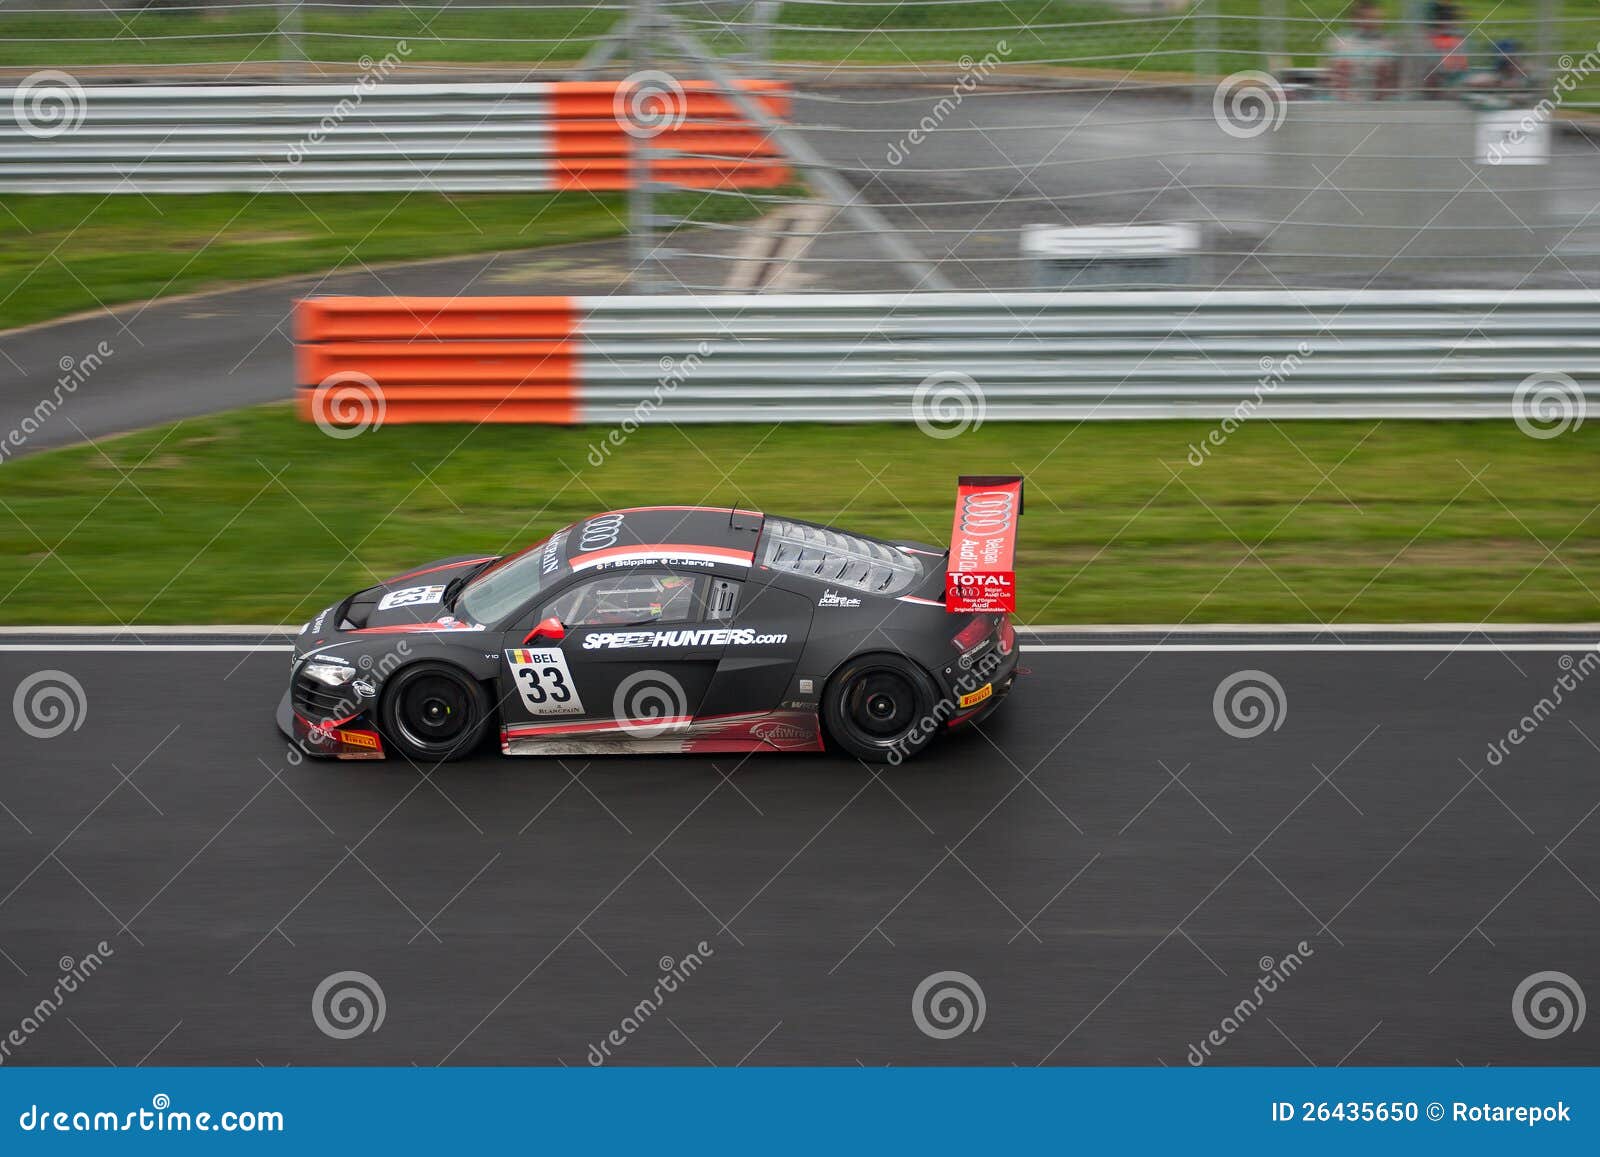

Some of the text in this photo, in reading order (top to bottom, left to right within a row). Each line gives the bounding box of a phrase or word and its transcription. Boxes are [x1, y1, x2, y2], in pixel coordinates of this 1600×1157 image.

[949, 572, 1010, 585] TOTAL
[532, 653, 558, 664] BEL
[518, 666, 572, 704] 33
